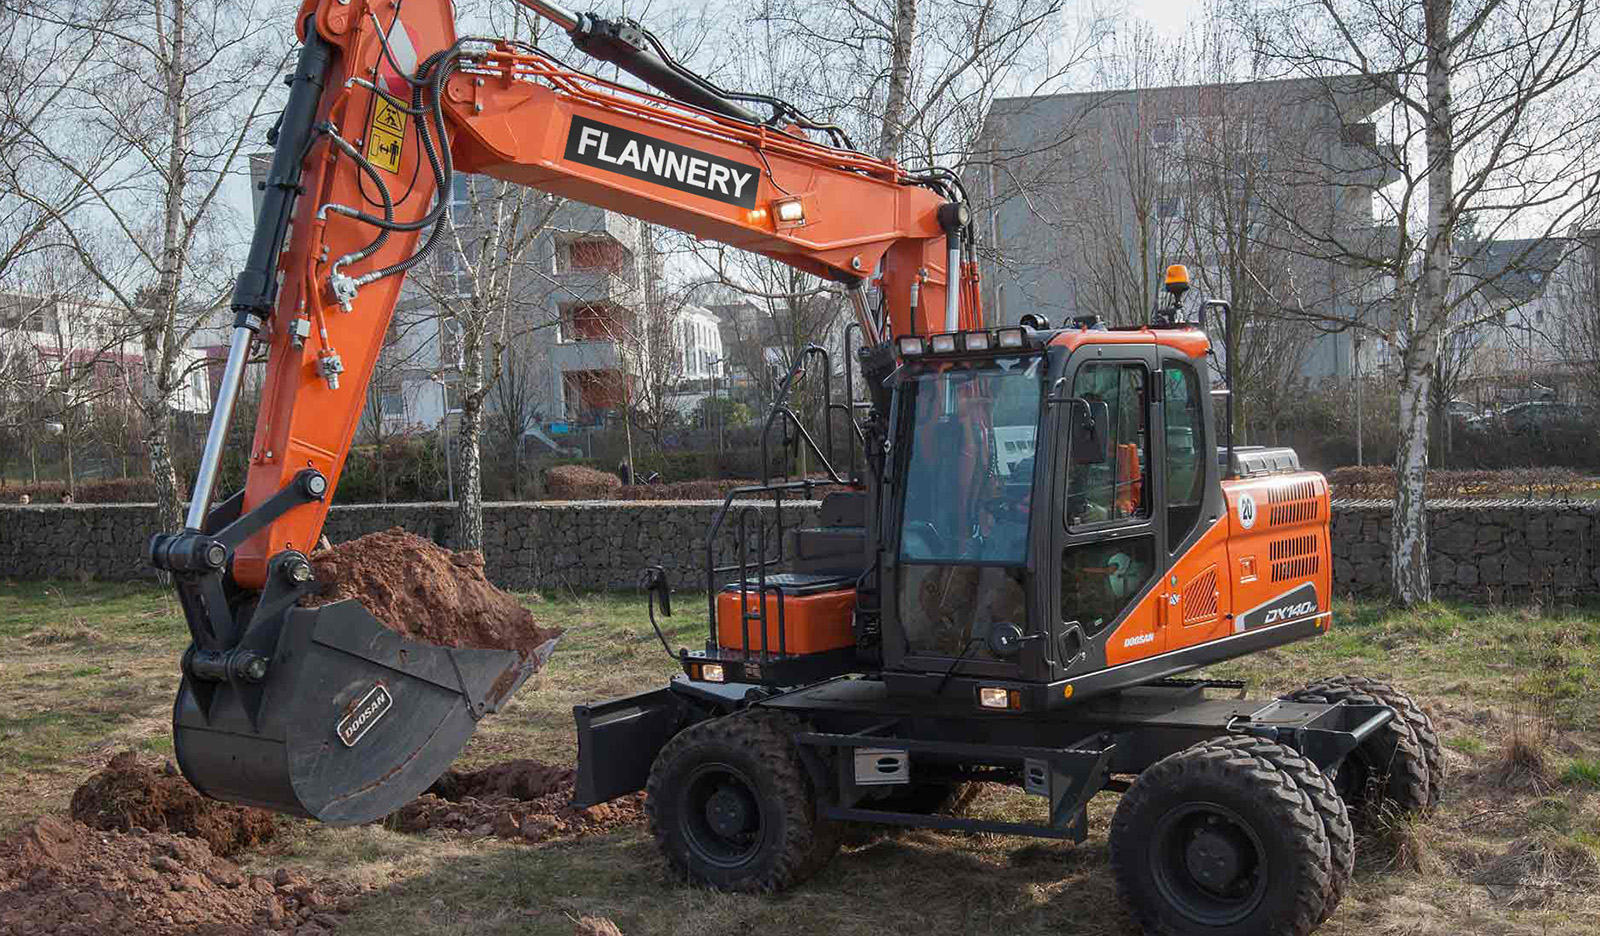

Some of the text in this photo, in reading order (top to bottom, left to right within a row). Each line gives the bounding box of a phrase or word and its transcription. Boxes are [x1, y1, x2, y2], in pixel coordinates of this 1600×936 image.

[577, 125, 753, 198] FLANNERY
[1241, 498, 1253, 520] 20
[1123, 632, 1155, 648] DOOSAN
[345, 692, 386, 738] DOOSAN
